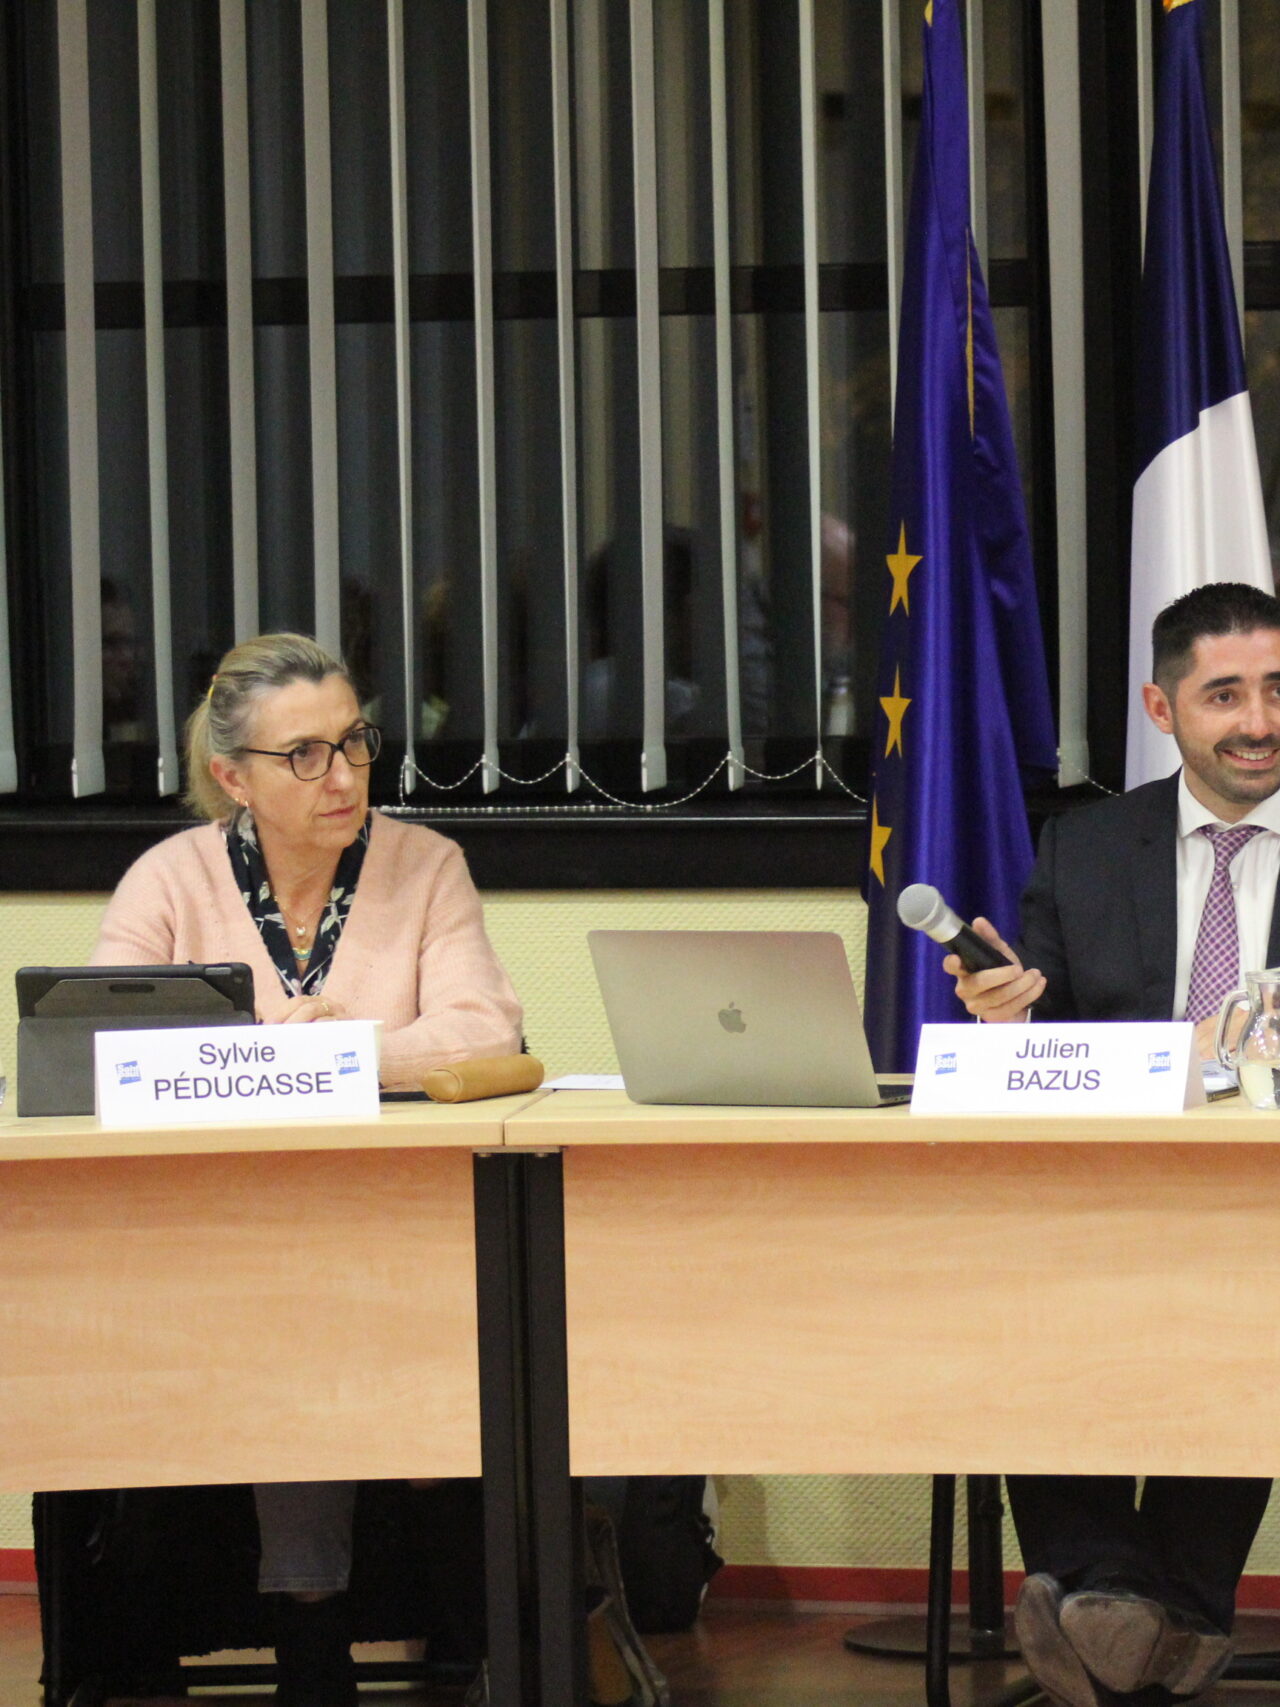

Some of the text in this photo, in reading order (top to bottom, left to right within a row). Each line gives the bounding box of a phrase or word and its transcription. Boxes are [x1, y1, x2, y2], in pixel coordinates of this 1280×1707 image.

[199, 1041, 276, 1070] Sylvie
[1015, 1038, 1090, 1059] Julien
[154, 1071, 334, 1101] PÉDUCASSE
[1007, 1069, 1101, 1091] BAZUS
